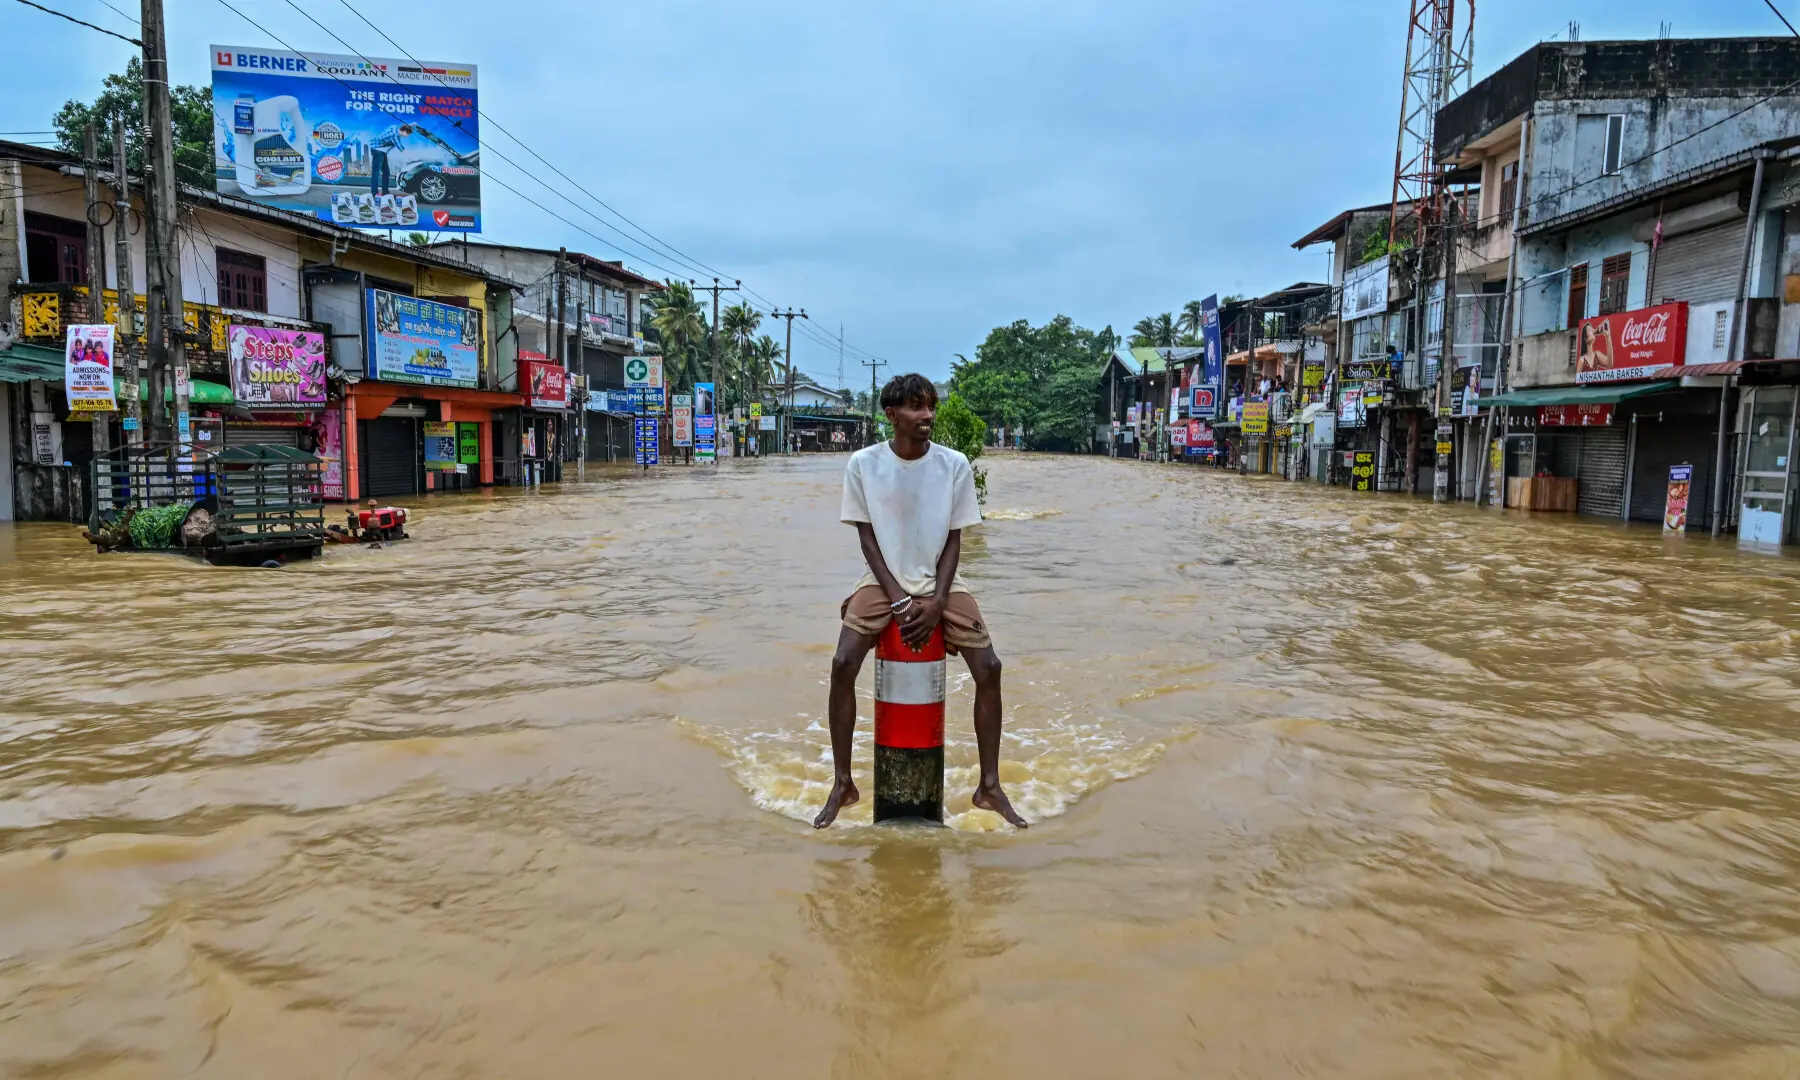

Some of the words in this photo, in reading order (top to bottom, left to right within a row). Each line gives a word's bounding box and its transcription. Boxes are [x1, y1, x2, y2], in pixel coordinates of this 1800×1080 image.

[237, 53, 307, 72] BERNER
[317, 66, 386, 78] COOLANT
[398, 72, 420, 80] MADE
[422, 73, 431, 81] IN
[433, 74, 471, 84] GERMANY
[350, 90, 375, 101] THE
[379, 92, 422, 104] RIGHT
[425, 96, 473, 107] MATCH
[345, 101, 373, 112] FOR
[377, 103, 415, 114] YOUR
[420, 105, 473, 118] VEHICLE
[324, 131, 343, 140] HOAT
[319, 163, 342, 174] ORIGINAL
[442, 167, 475, 175] Solution
[1621, 312, 1670, 347] Coca-Cola
[244, 335, 293, 365] Steps
[1640, 350, 1654, 359] Magic
[250, 361, 300, 383] Shoes
[1347, 365, 1371, 378] Salon
[1579, 370, 1615, 382] NISHANTHA
[1617, 367, 1643, 379] BAKERS
[461, 430, 477, 440] BETTING
[462, 445, 477, 456] CENTER
[323, 485, 343, 498] SHOES
